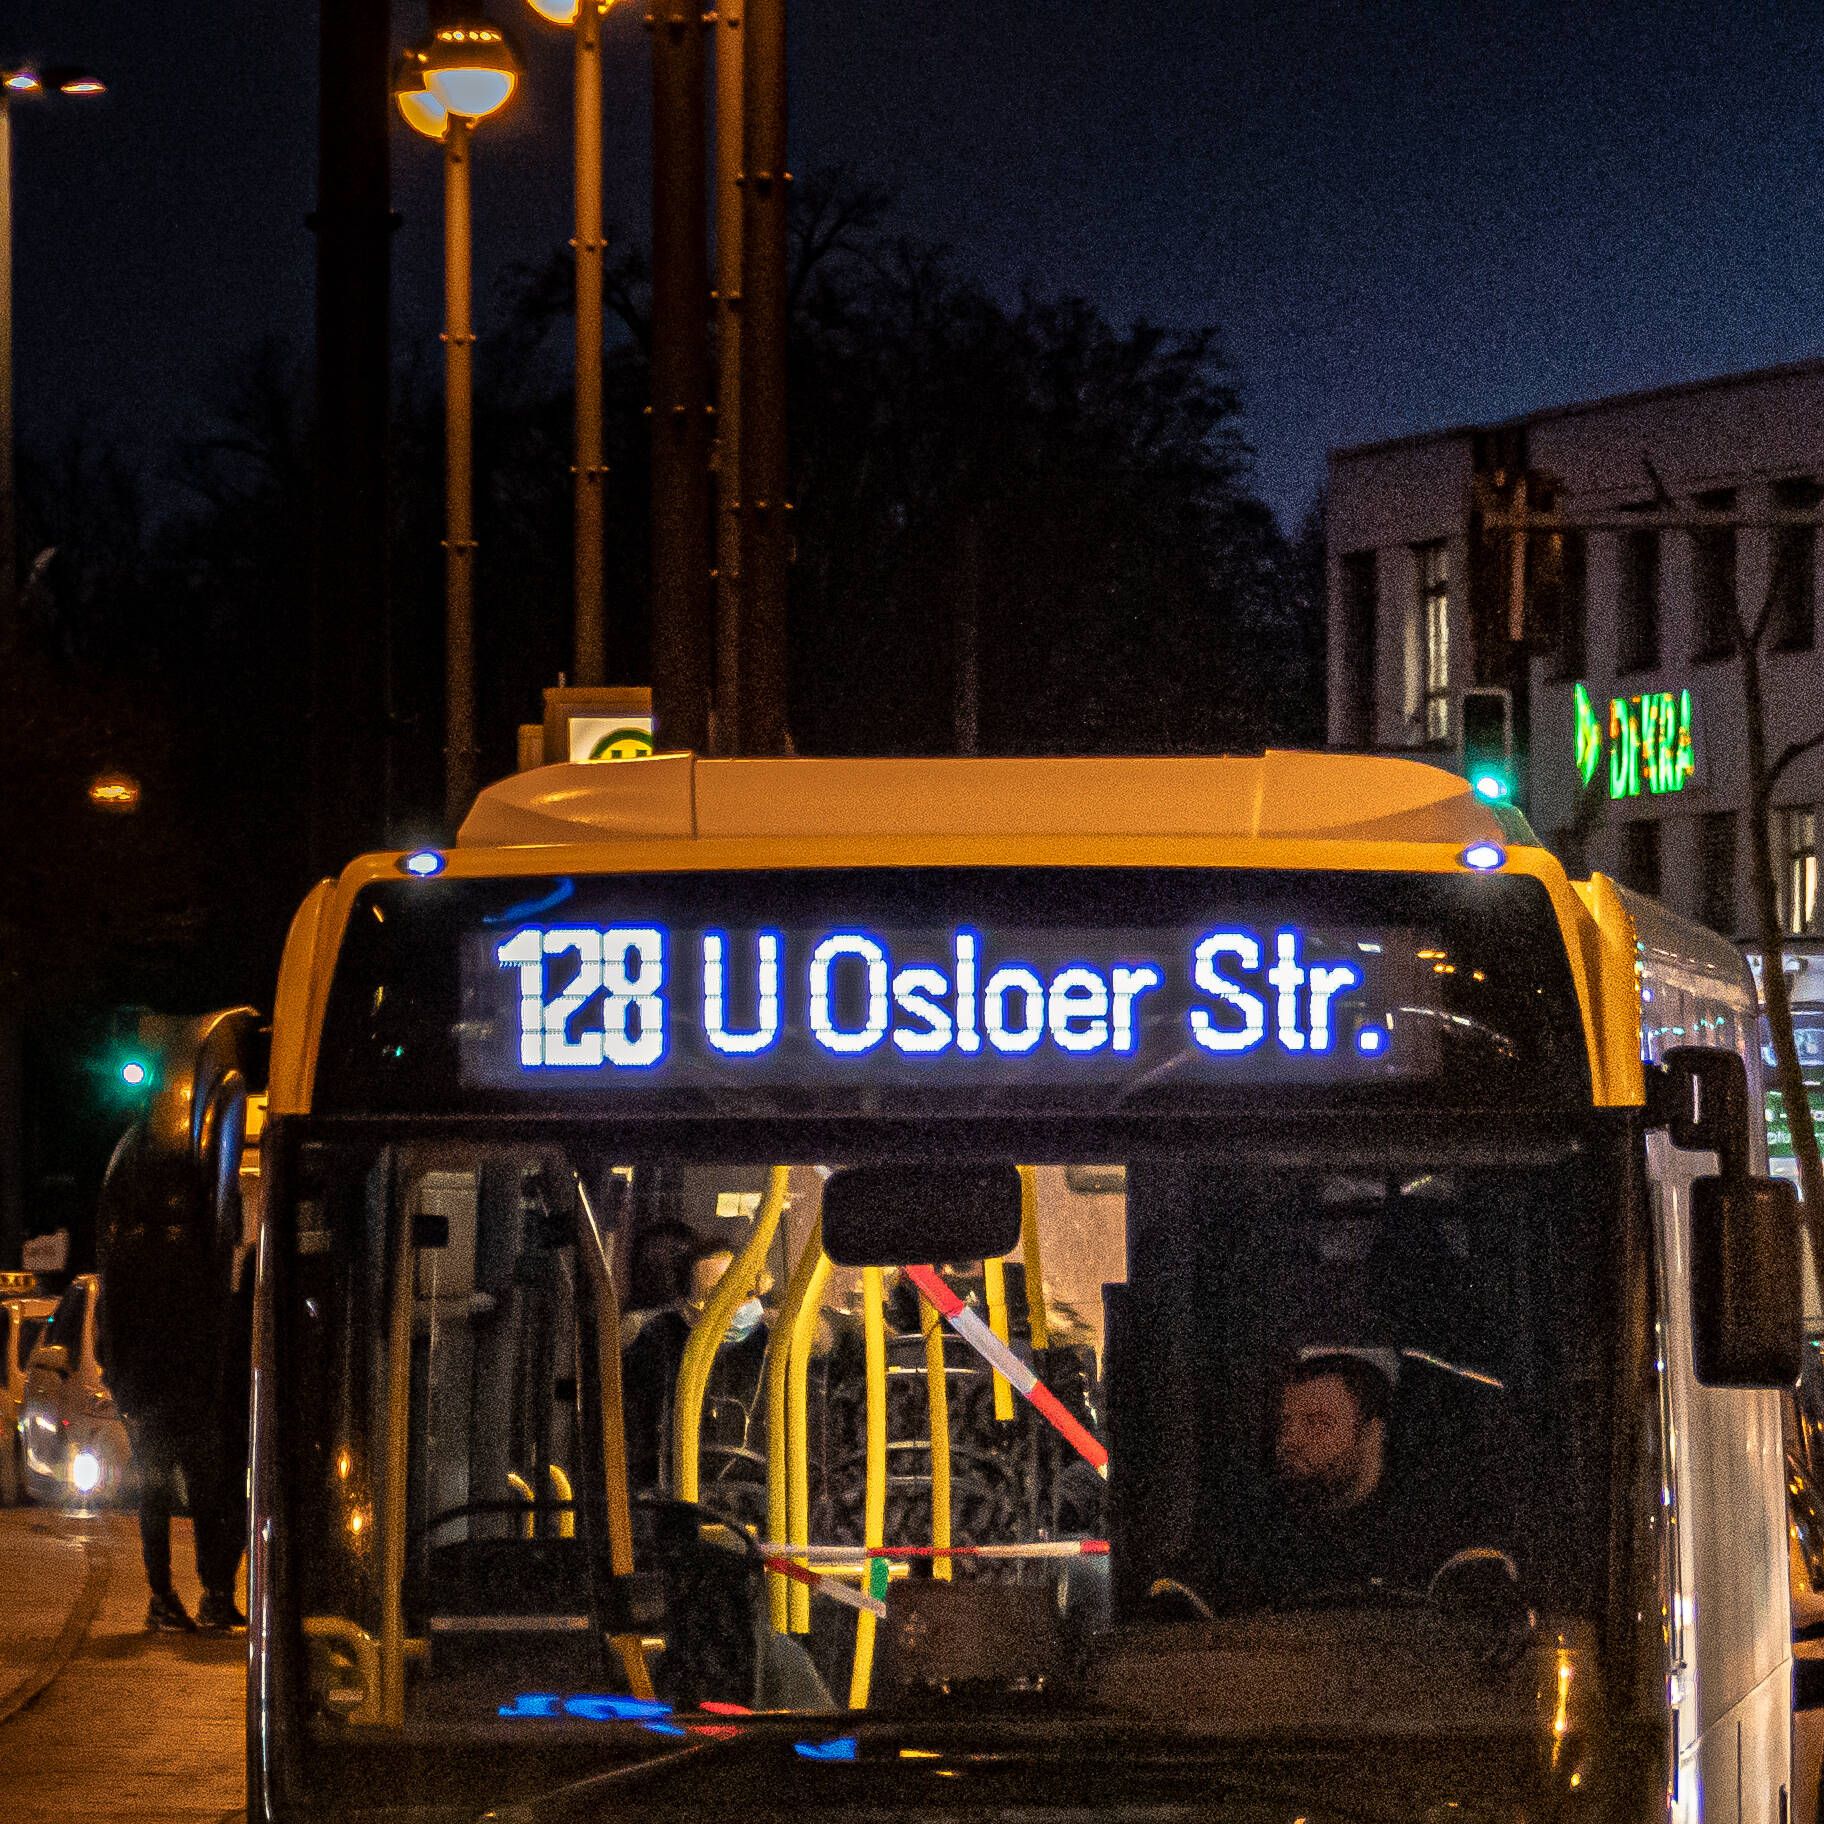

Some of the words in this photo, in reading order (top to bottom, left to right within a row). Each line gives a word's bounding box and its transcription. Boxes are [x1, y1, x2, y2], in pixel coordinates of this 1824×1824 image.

[497, 927, 668, 1066] 128
[702, 931, 779, 1053] U
[809, 931, 1159, 1054] Osloer
[1190, 931, 1390, 1054] Str.
